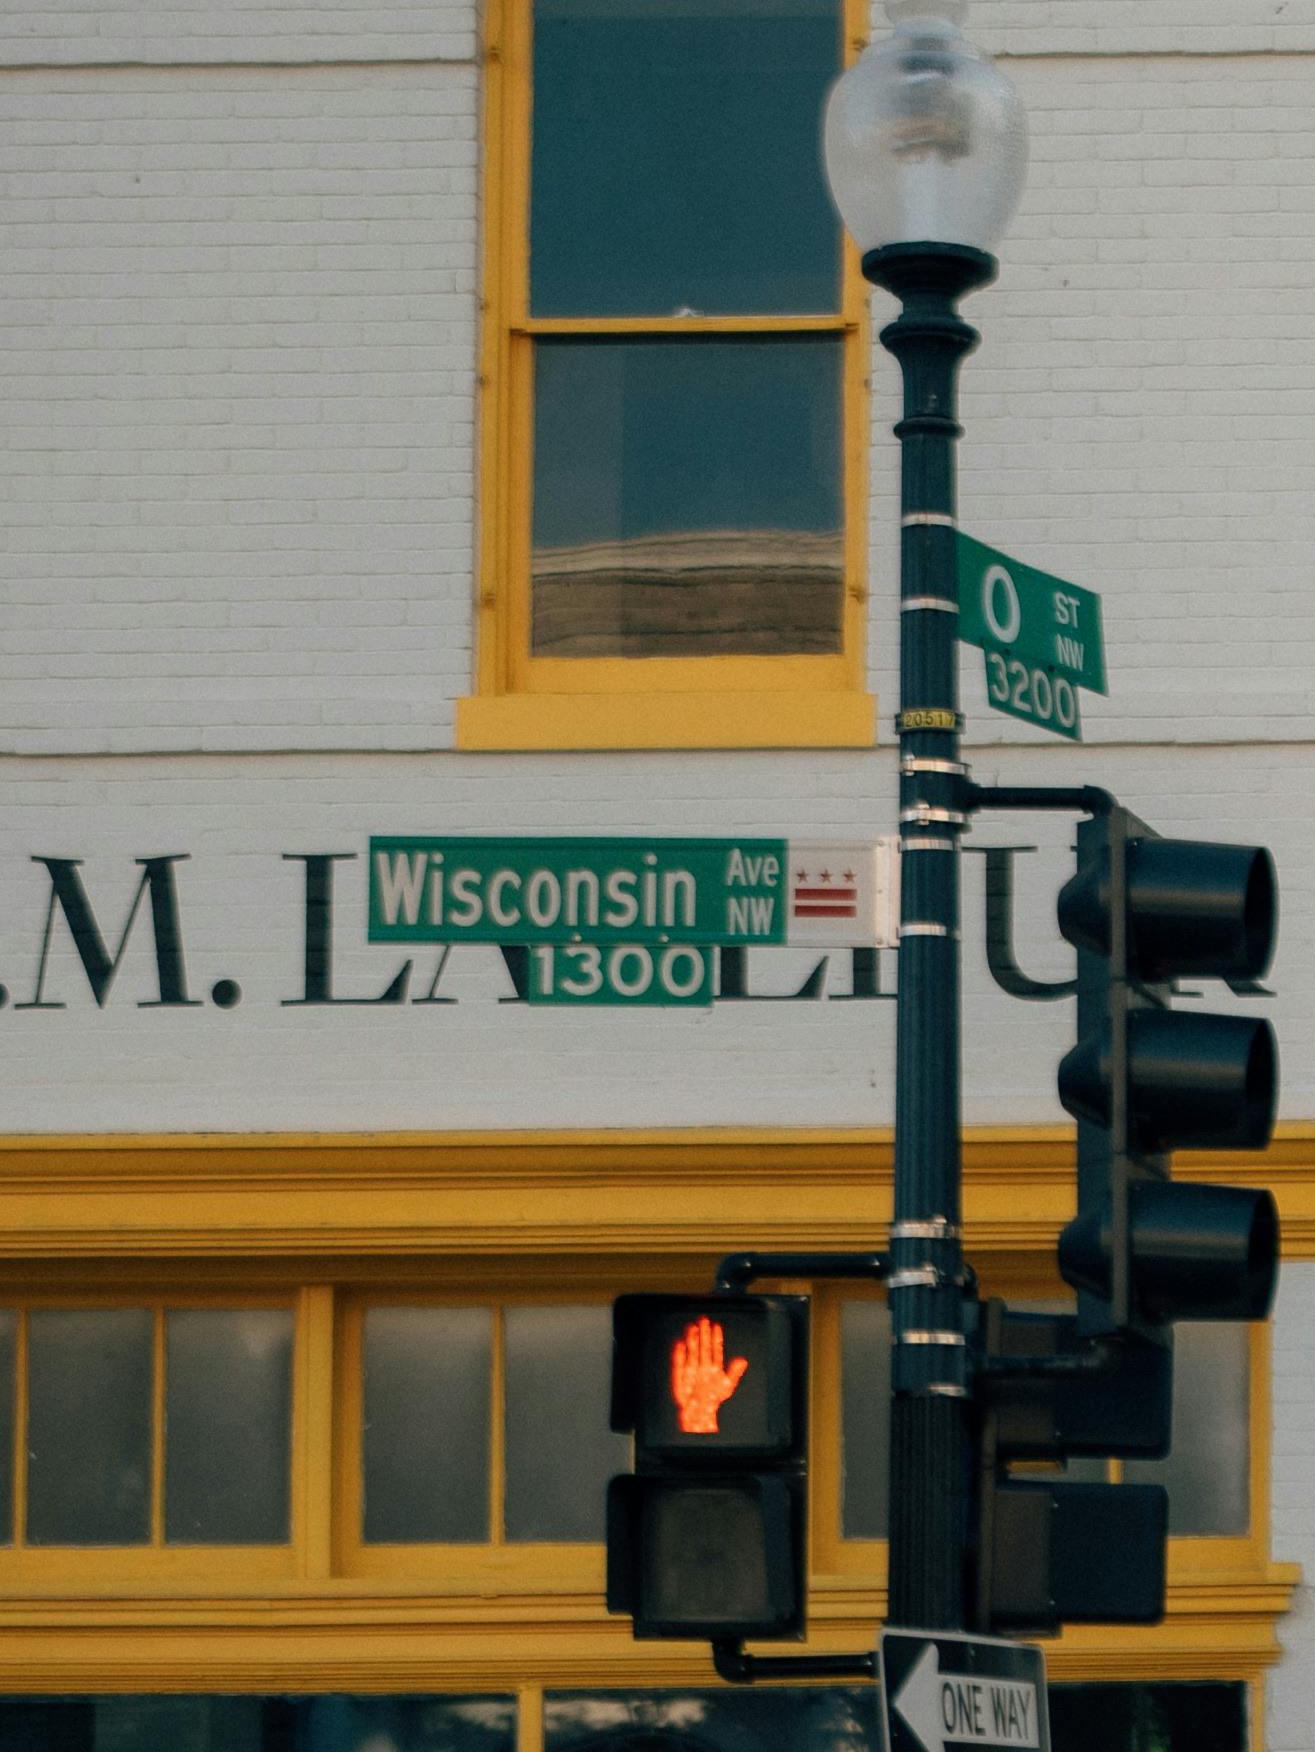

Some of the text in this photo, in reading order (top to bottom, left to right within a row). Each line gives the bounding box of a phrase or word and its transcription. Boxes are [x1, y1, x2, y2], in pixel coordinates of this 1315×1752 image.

[982, 563, 1021, 644] O
[1053, 591, 1081, 629] ST
[1055, 633, 1085, 672] NW
[988, 651, 1076, 729] 3200
[376, 848, 780, 929] Wisconsin Ave
[728, 896, 776, 936] NW
[535, 944, 705, 998] 1300
[942, 1680, 1031, 1740] ONE WAY
